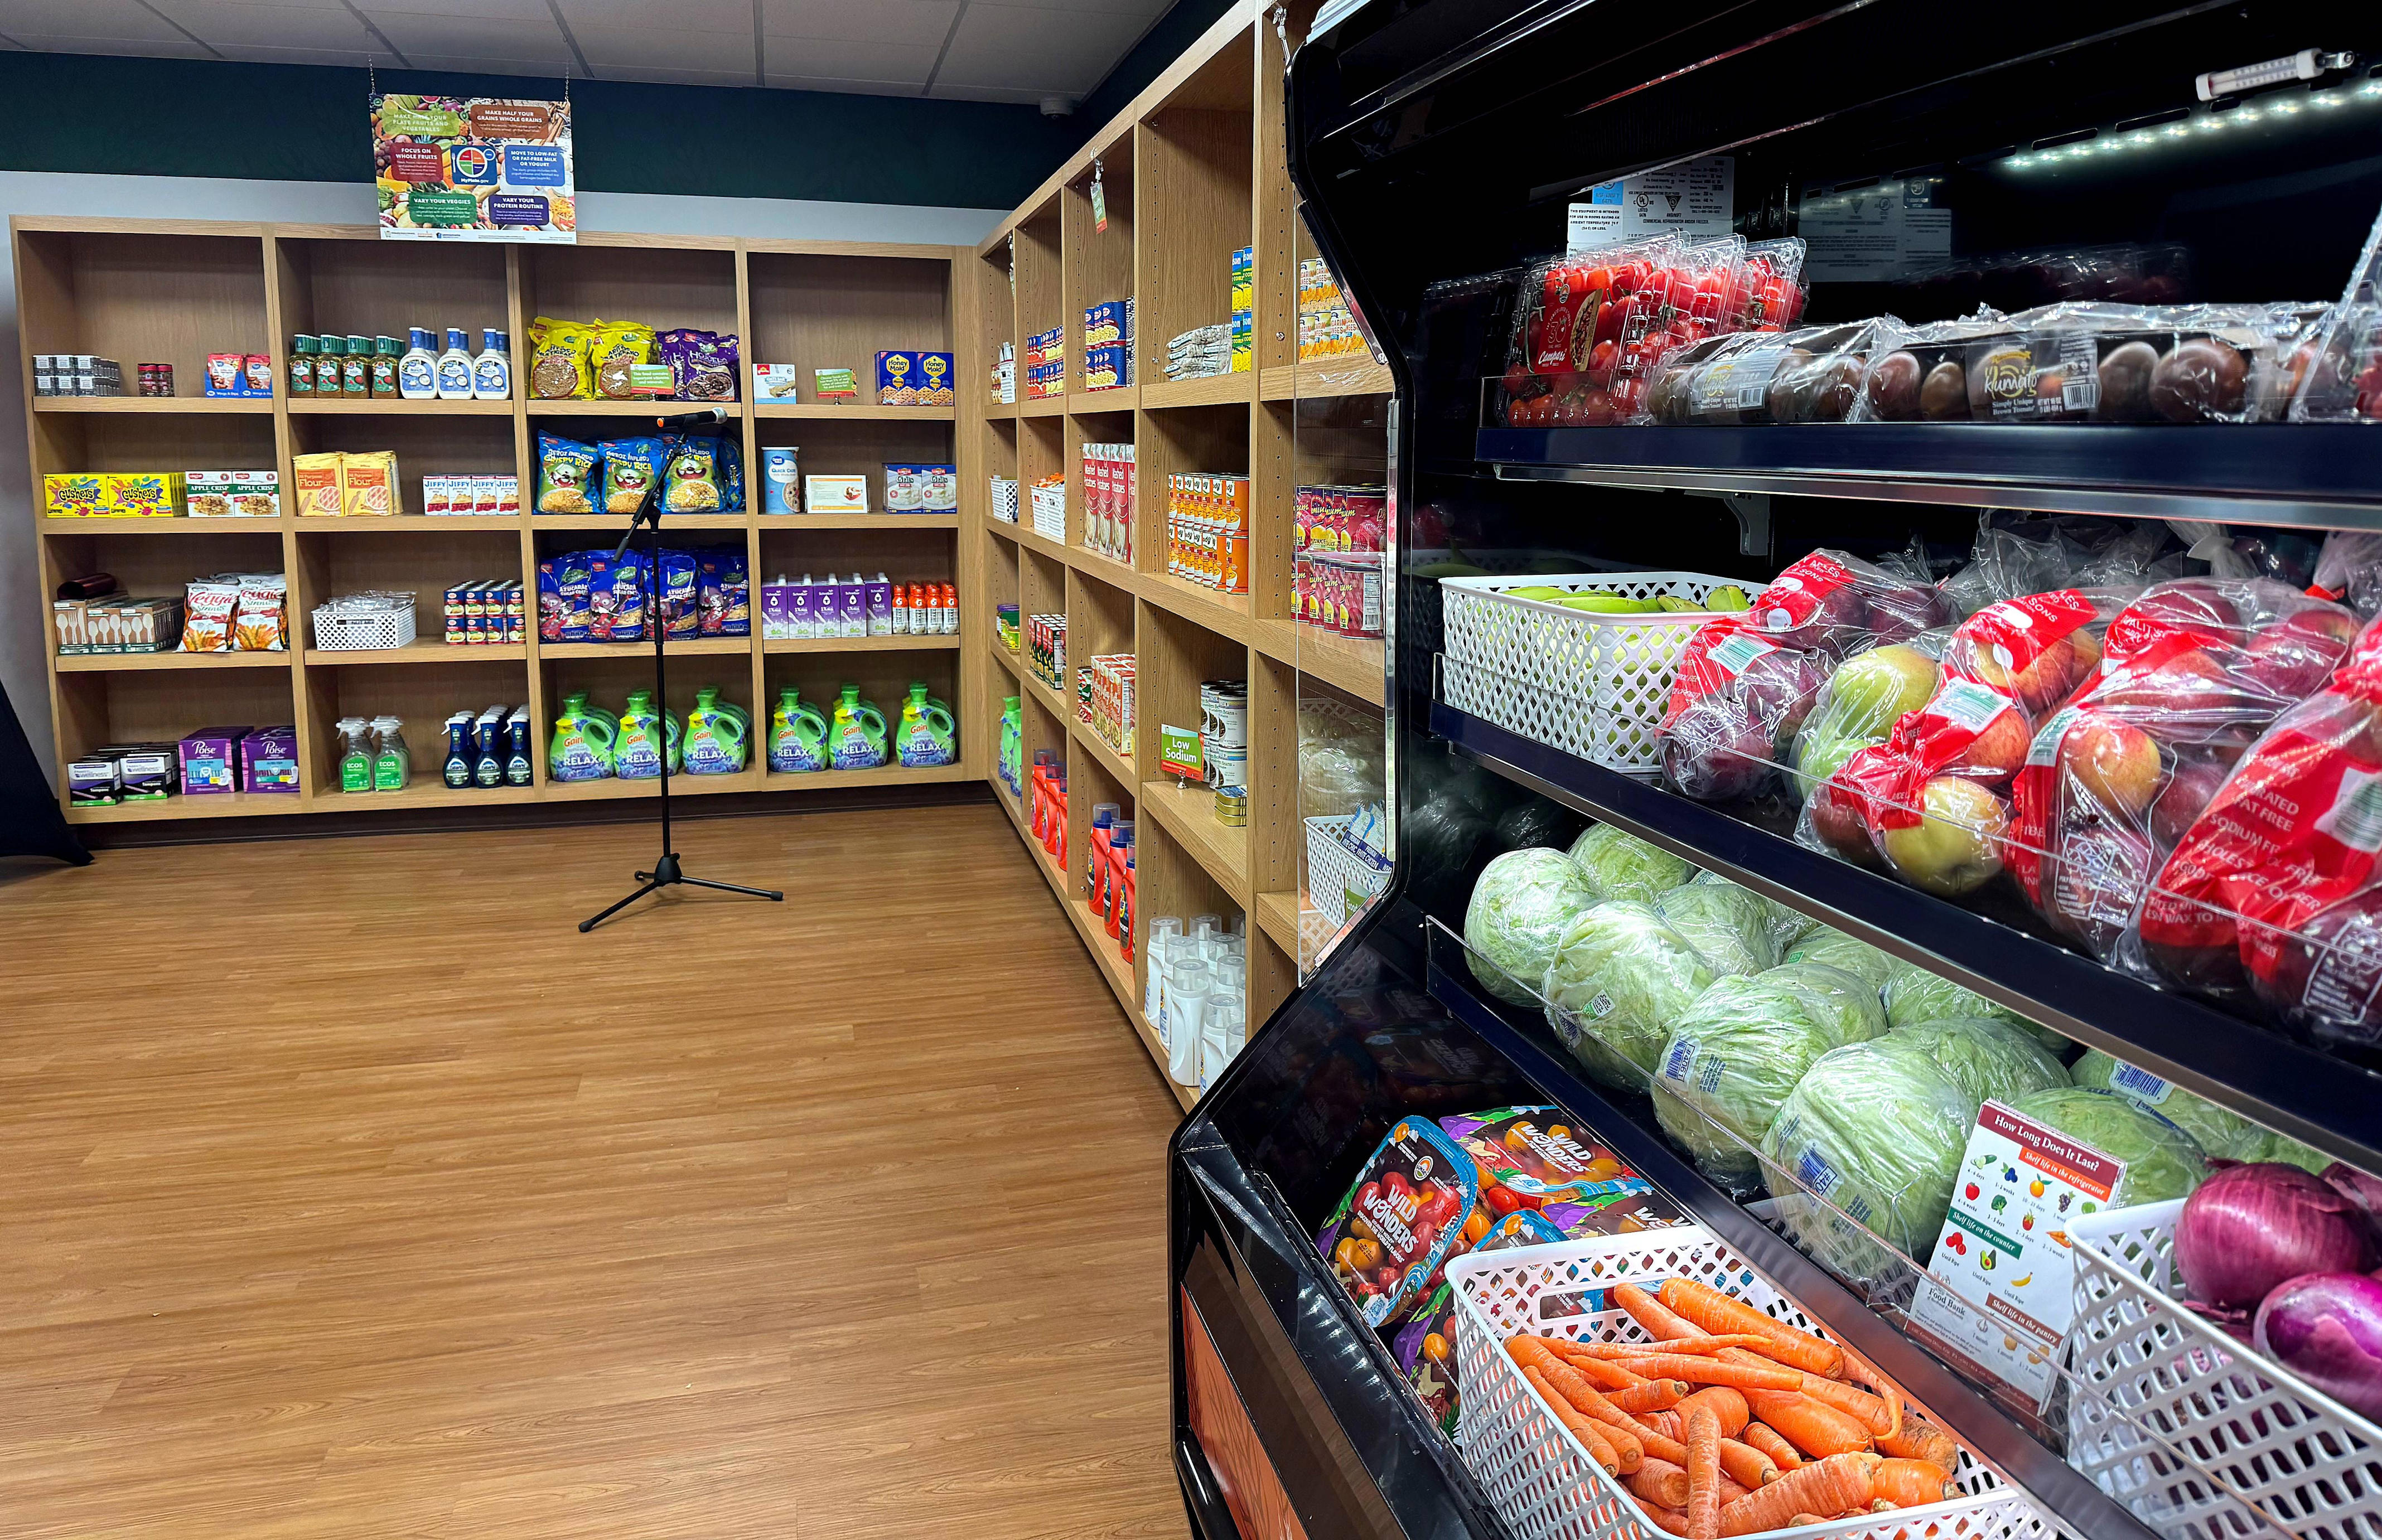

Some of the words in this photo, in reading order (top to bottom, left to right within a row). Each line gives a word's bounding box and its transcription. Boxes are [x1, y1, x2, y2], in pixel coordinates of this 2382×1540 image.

[888, 359, 909, 368] Honey
[925, 360, 945, 369] Honey
[1992, 399, 2012, 408] Simply
[575, 458, 593, 469] RICE
[634, 461, 652, 470] RICE
[299, 478, 323, 487] Flour
[348, 477, 373, 487] Flour
[1799, 568, 1824, 582] SONS
[189, 591, 238, 607] Veggie
[2028, 597, 2058, 623] SONS
[777, 729, 795, 739] Gain
[842, 726, 861, 736] Gain
[910, 724, 927, 734] Gain
[1906, 727, 1922, 738] FREE
[626, 734, 646, 744] Gain
[693, 731, 712, 740] Gain
[563, 736, 583, 747] Gain
[1172, 737, 1190, 750] Low
[191, 740, 217, 755] Poise
[261, 740, 287, 755] Poise
[777, 749, 810, 757] RELAX
[842, 745, 874, 754] RELAX
[909, 743, 942, 752] RELAX
[626, 753, 661, 763] RELAX
[692, 750, 727, 759] RELAX
[1165, 748, 1197, 764] Sodium
[563, 756, 599, 766] RELAX
[2259, 807, 2294, 832] FREE
[2210, 813, 2263, 846] SODIUM
[2166, 910, 2192, 923] WAX
[2196, 912, 2216, 923] TO
[1678, 1048, 1692, 1078] #4061
[1520, 1123, 1596, 1172] WONDERS
[1552, 1132, 1592, 1160] WILD
[1994, 1115, 2017, 1133] How
[2017, 1125, 2041, 1147] Long
[2042, 1137, 2065, 1156] Does
[2066, 1148, 2075, 1160] It
[2075, 1152, 2100, 1171] Last?
[1976, 1172, 1985, 1180] days
[2025, 1151, 2041, 1166] Shelf
[2041, 1158, 2051, 1170] life
[2051, 1163, 2059, 1171] in
[2059, 1166, 2069, 1178] the
[2068, 1171, 2105, 1196] refrigerator
[2003, 1187, 2014, 1196] weeks
[1387, 1183, 1418, 1222] WILD
[1966, 1203, 1977, 1212] weeks
[1363, 1189, 1419, 1253] WONDERS
[1996, 1219, 2005, 1228] days
[1953, 1211, 1967, 1226] Shelf
[1967, 1219, 1977, 1230] life
[1984, 1229, 1993, 1239] the
[1993, 1235, 2016, 1251] counter
[2025, 1234, 2035, 1243] days
[1941, 1252, 1951, 1263] Until
[1951, 1257, 1960, 1267] Ripe
[2052, 1250, 2065, 1259] weeks
[1972, 1271, 1983, 1281] Until
[1982, 1277, 1992, 1287] Ripe
[1928, 1287, 1946, 1305] Food
[1947, 1297, 1966, 1316] Bank
[2004, 1289, 2014, 1300] Until
[2014, 1295, 2025, 1305] Ripe
[1992, 1298, 2008, 1315] Shelf
[2008, 1307, 2018, 1320] life
[2018, 1314, 2025, 1323] in
[2025, 1318, 2035, 1330] the
[2035, 1324, 2058, 1344] pantry
